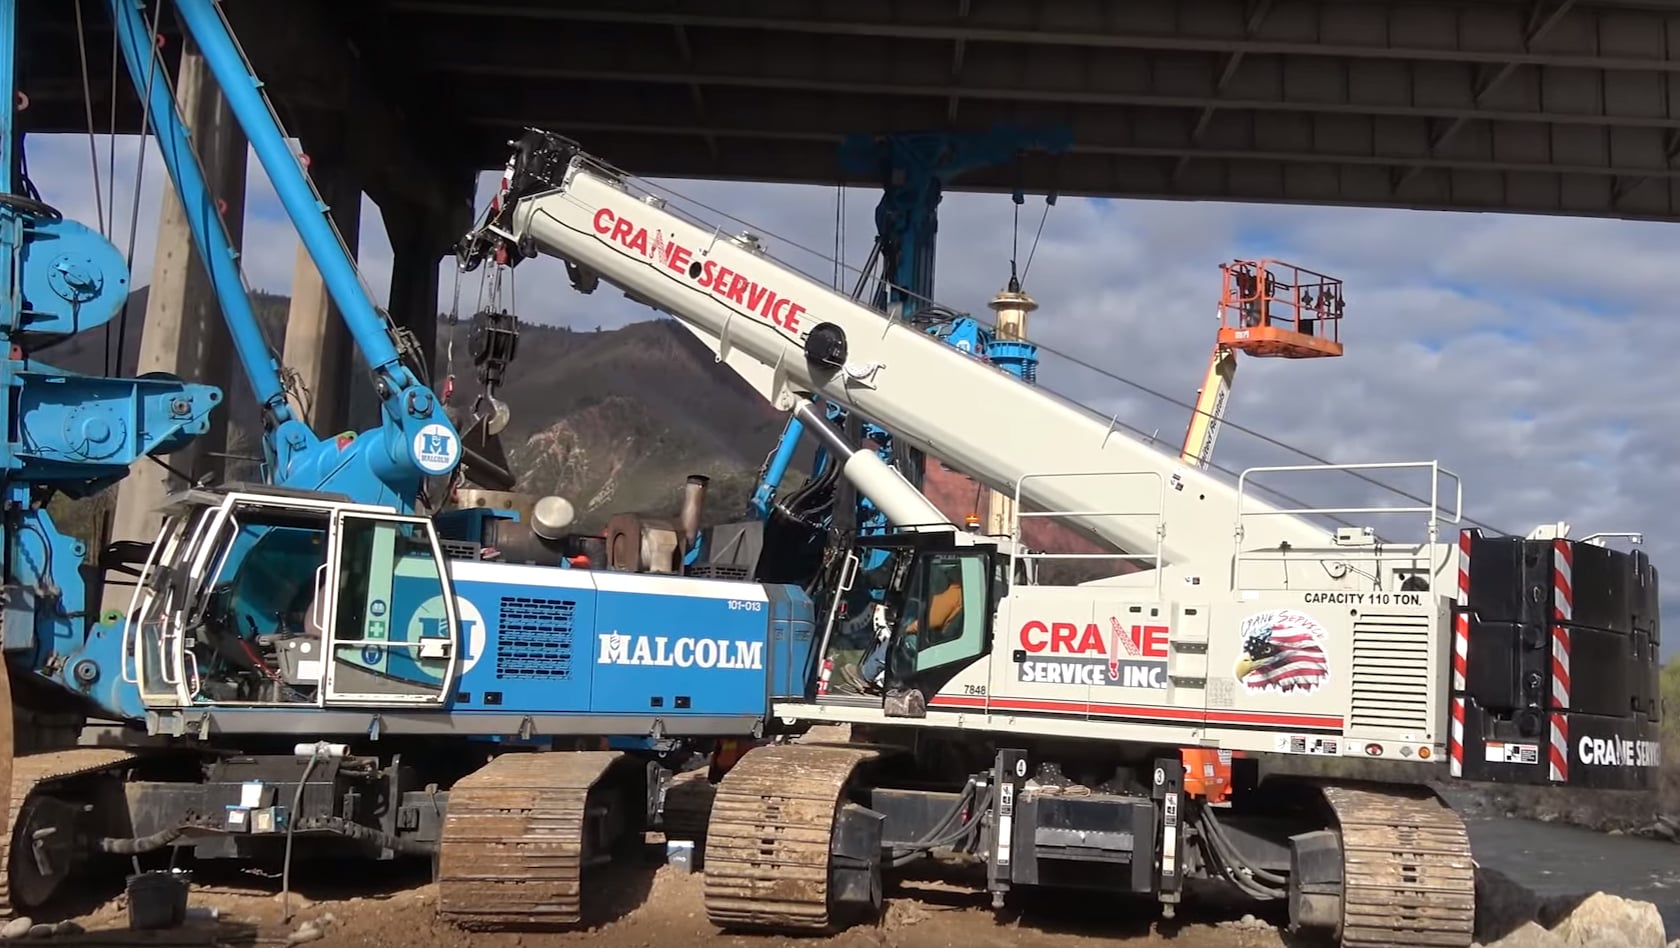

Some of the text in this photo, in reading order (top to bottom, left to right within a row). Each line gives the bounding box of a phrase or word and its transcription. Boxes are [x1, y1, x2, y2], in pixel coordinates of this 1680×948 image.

[593, 207, 806, 334] CRANE SERVICE
[727, 600, 761, 612] 101-013
[1304, 593, 1364, 605] CAPACITY
[1368, 594, 1390, 605] 110
[597, 631, 763, 670] MALCOLM
[1020, 617, 1169, 657] CRANE
[1022, 661, 1167, 688] SERVICE INC.
[964, 685, 986, 695] 7848
[1578, 734, 1634, 766] CRANE
